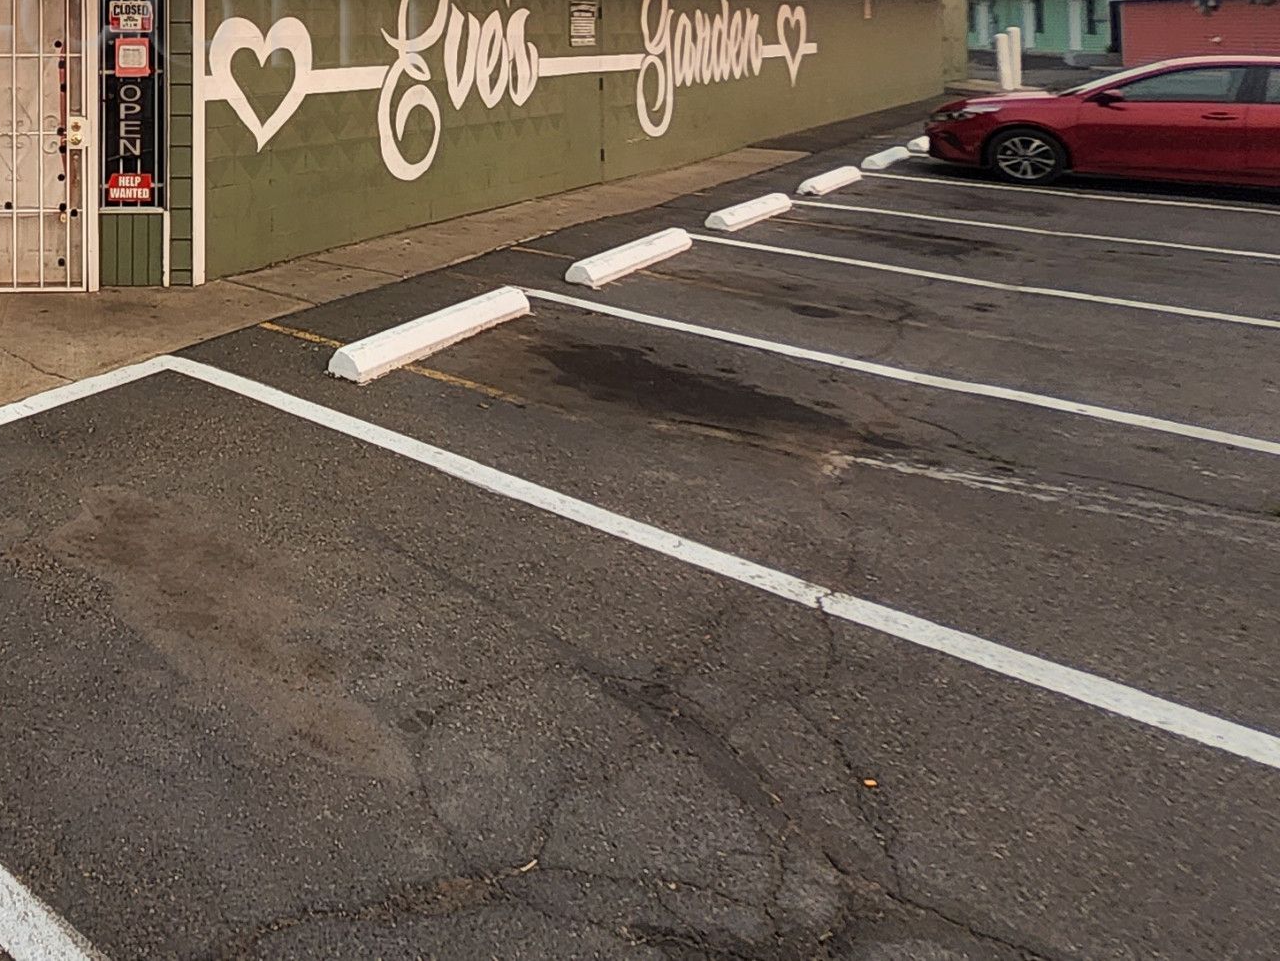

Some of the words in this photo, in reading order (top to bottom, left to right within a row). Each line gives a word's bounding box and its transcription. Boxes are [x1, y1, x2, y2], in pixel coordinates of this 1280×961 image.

[113, 4, 149, 16] CLOSED
[120, 84, 141, 156] OPEN
[118, 176, 141, 187] HELP
[109, 187, 150, 199] WANTED
